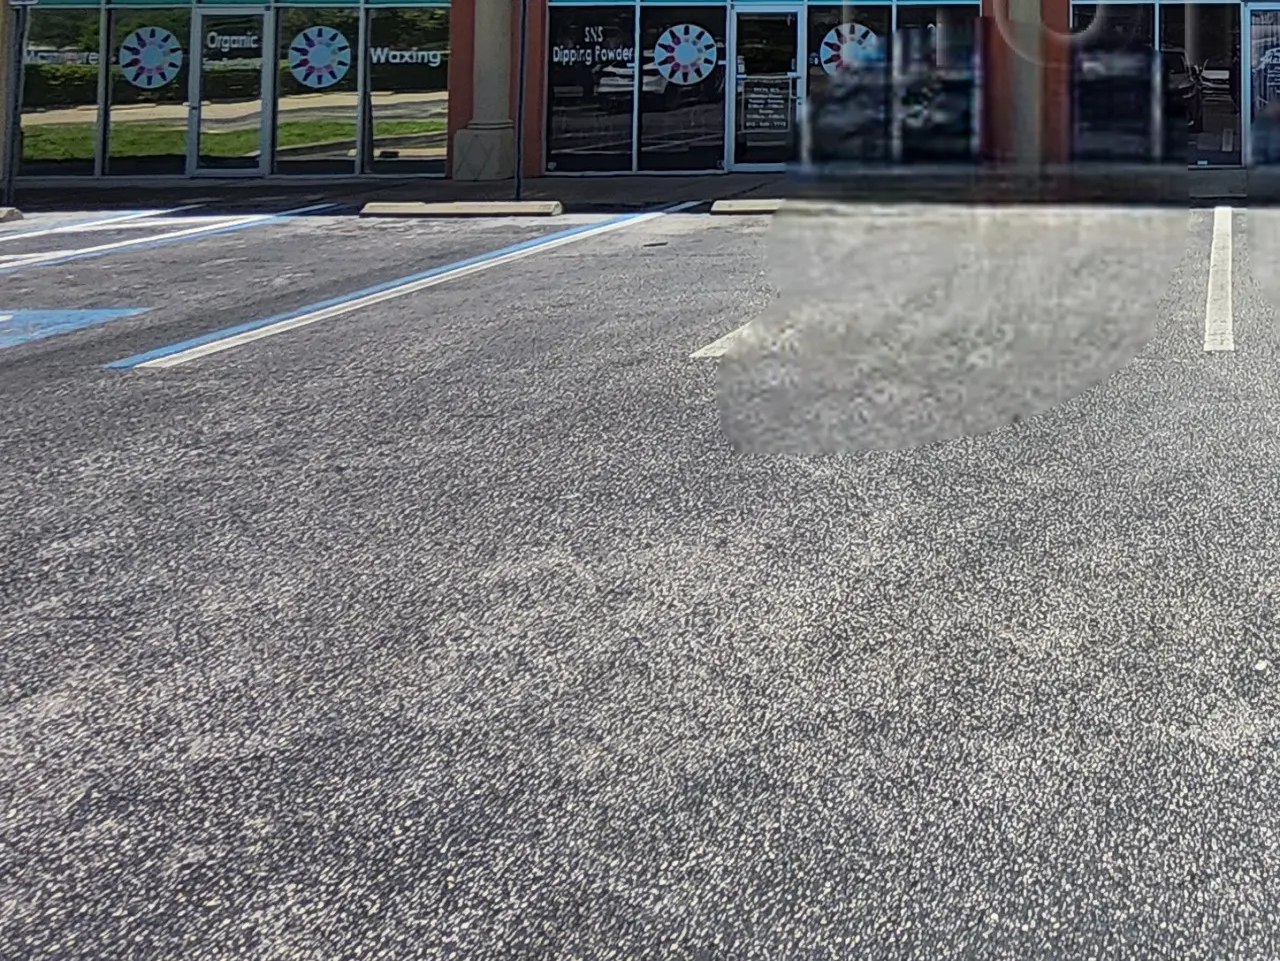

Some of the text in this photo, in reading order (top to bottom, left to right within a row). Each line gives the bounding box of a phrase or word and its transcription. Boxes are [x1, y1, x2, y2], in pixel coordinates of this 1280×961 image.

[206, 31, 259, 52] Organic
[370, 46, 441, 67] Waxing
[553, 44, 633, 66] Dipping Powder
